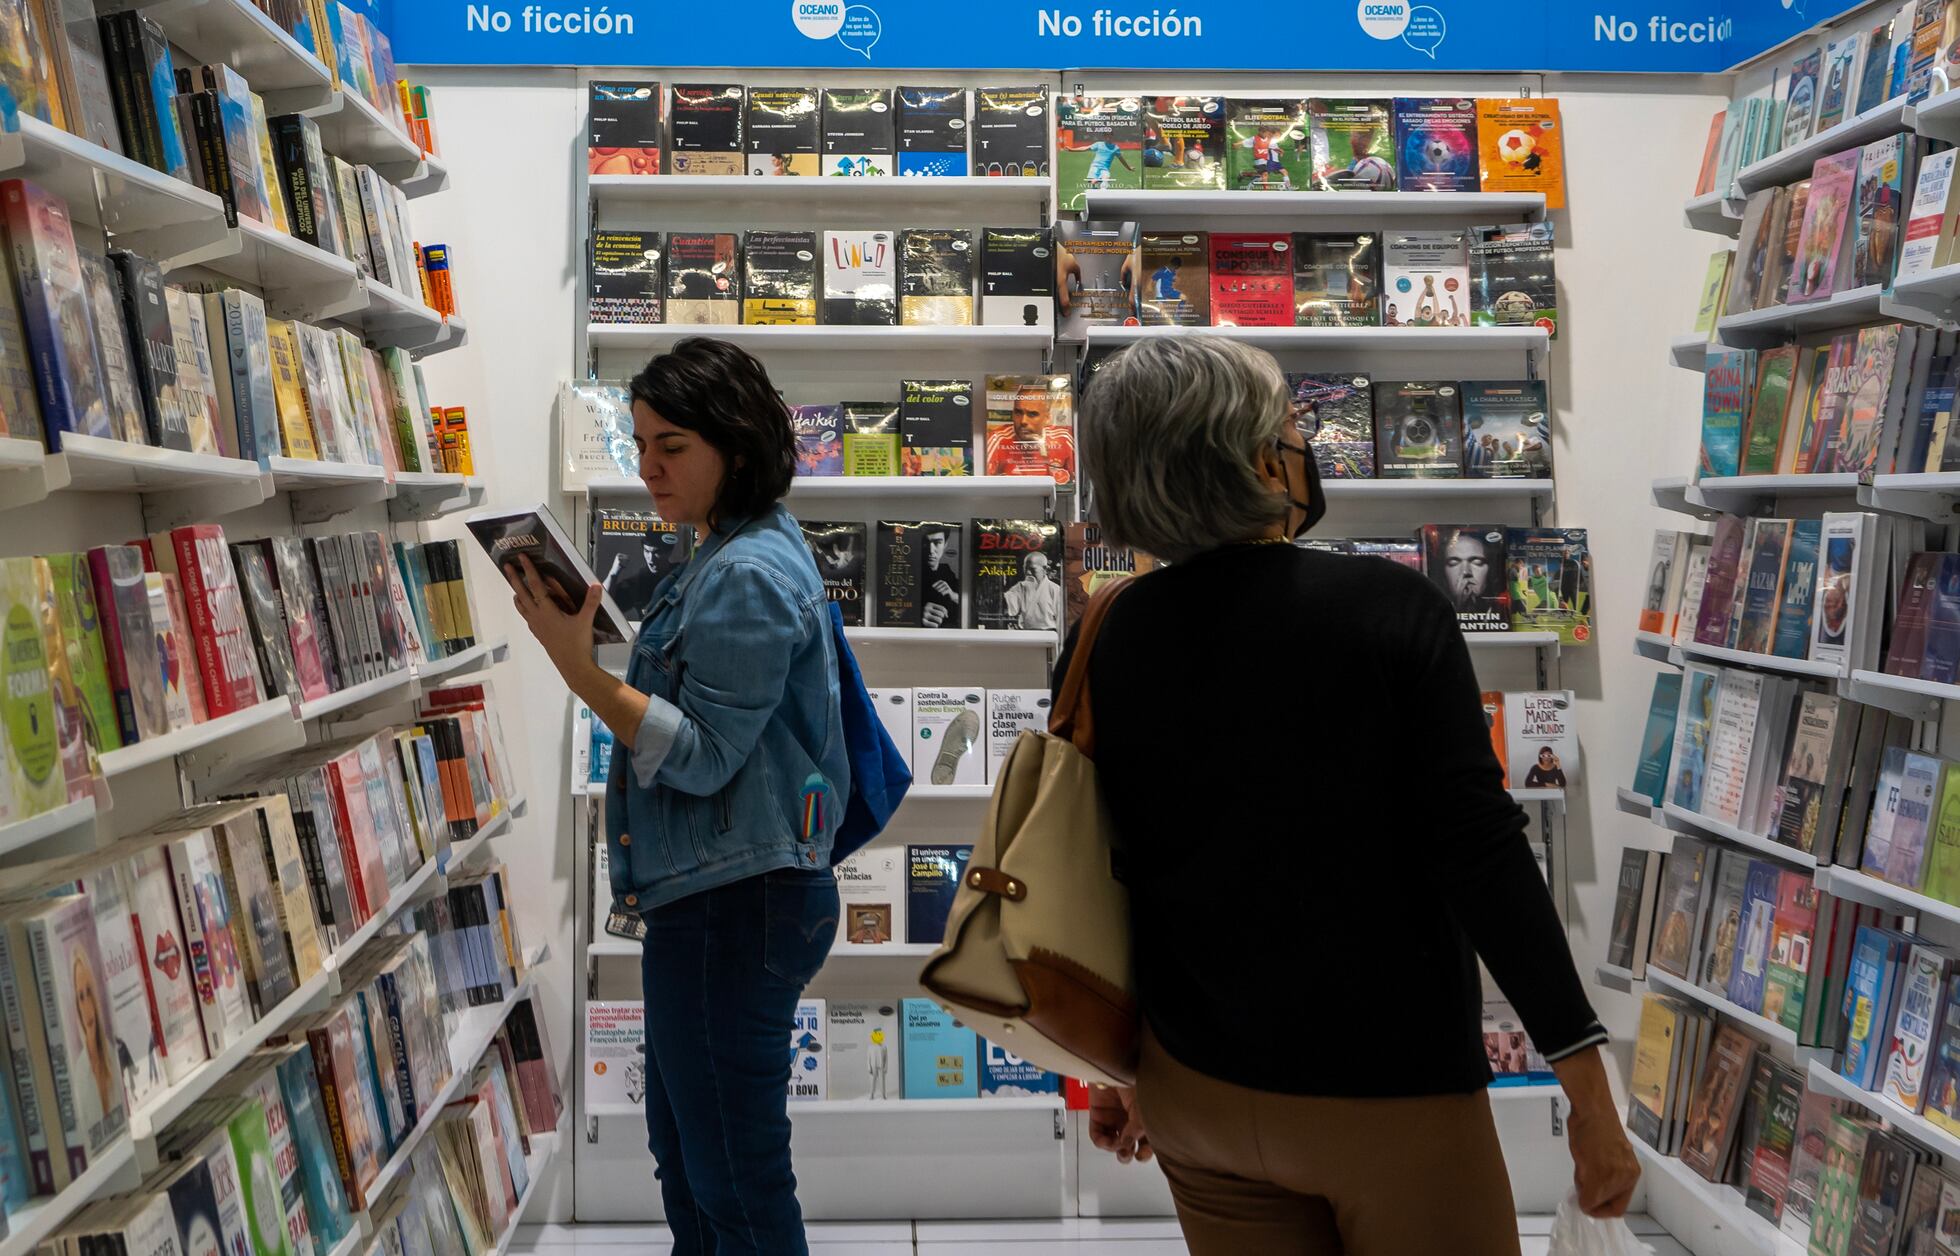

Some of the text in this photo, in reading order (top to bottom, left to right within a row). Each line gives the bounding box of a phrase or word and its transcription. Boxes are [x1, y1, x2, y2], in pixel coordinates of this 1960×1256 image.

[800, 4, 838, 15] OCEANO
[1365, 5, 1403, 15] OCEANO
[466, 4, 634, 34] No ficción
[1037, 9, 1202, 37] No ficción
[1593, 14, 1733, 43] No ficción
[594, 134, 600, 142] T
[676, 138, 683, 146] T
[904, 139, 911, 147] T
[752, 141, 759, 149] T
[595, 285, 601, 293] T
[908, 283, 915, 291] T
[988, 282, 995, 290] T
[227, 302, 244, 337] 2030
[1708, 367, 1741, 390] CHINA
[907, 395, 944, 403] del color
[1707, 391, 1743, 413] TOWN
[906, 434, 913, 442] T
[603, 520, 677, 532] BRUCE LEE
[841, 578, 852, 587] del
[992, 693, 1021, 703] Rubén
[1524, 698, 1536, 709] La
[992, 711, 1003, 719] La
[1526, 710, 1559, 723] MADRE
[992, 720, 1016, 728] clase
[1536, 724, 1564, 734] MUNDO
[844, 873, 872, 881] falacias
[389, 1015, 407, 1064] GRACIAS
